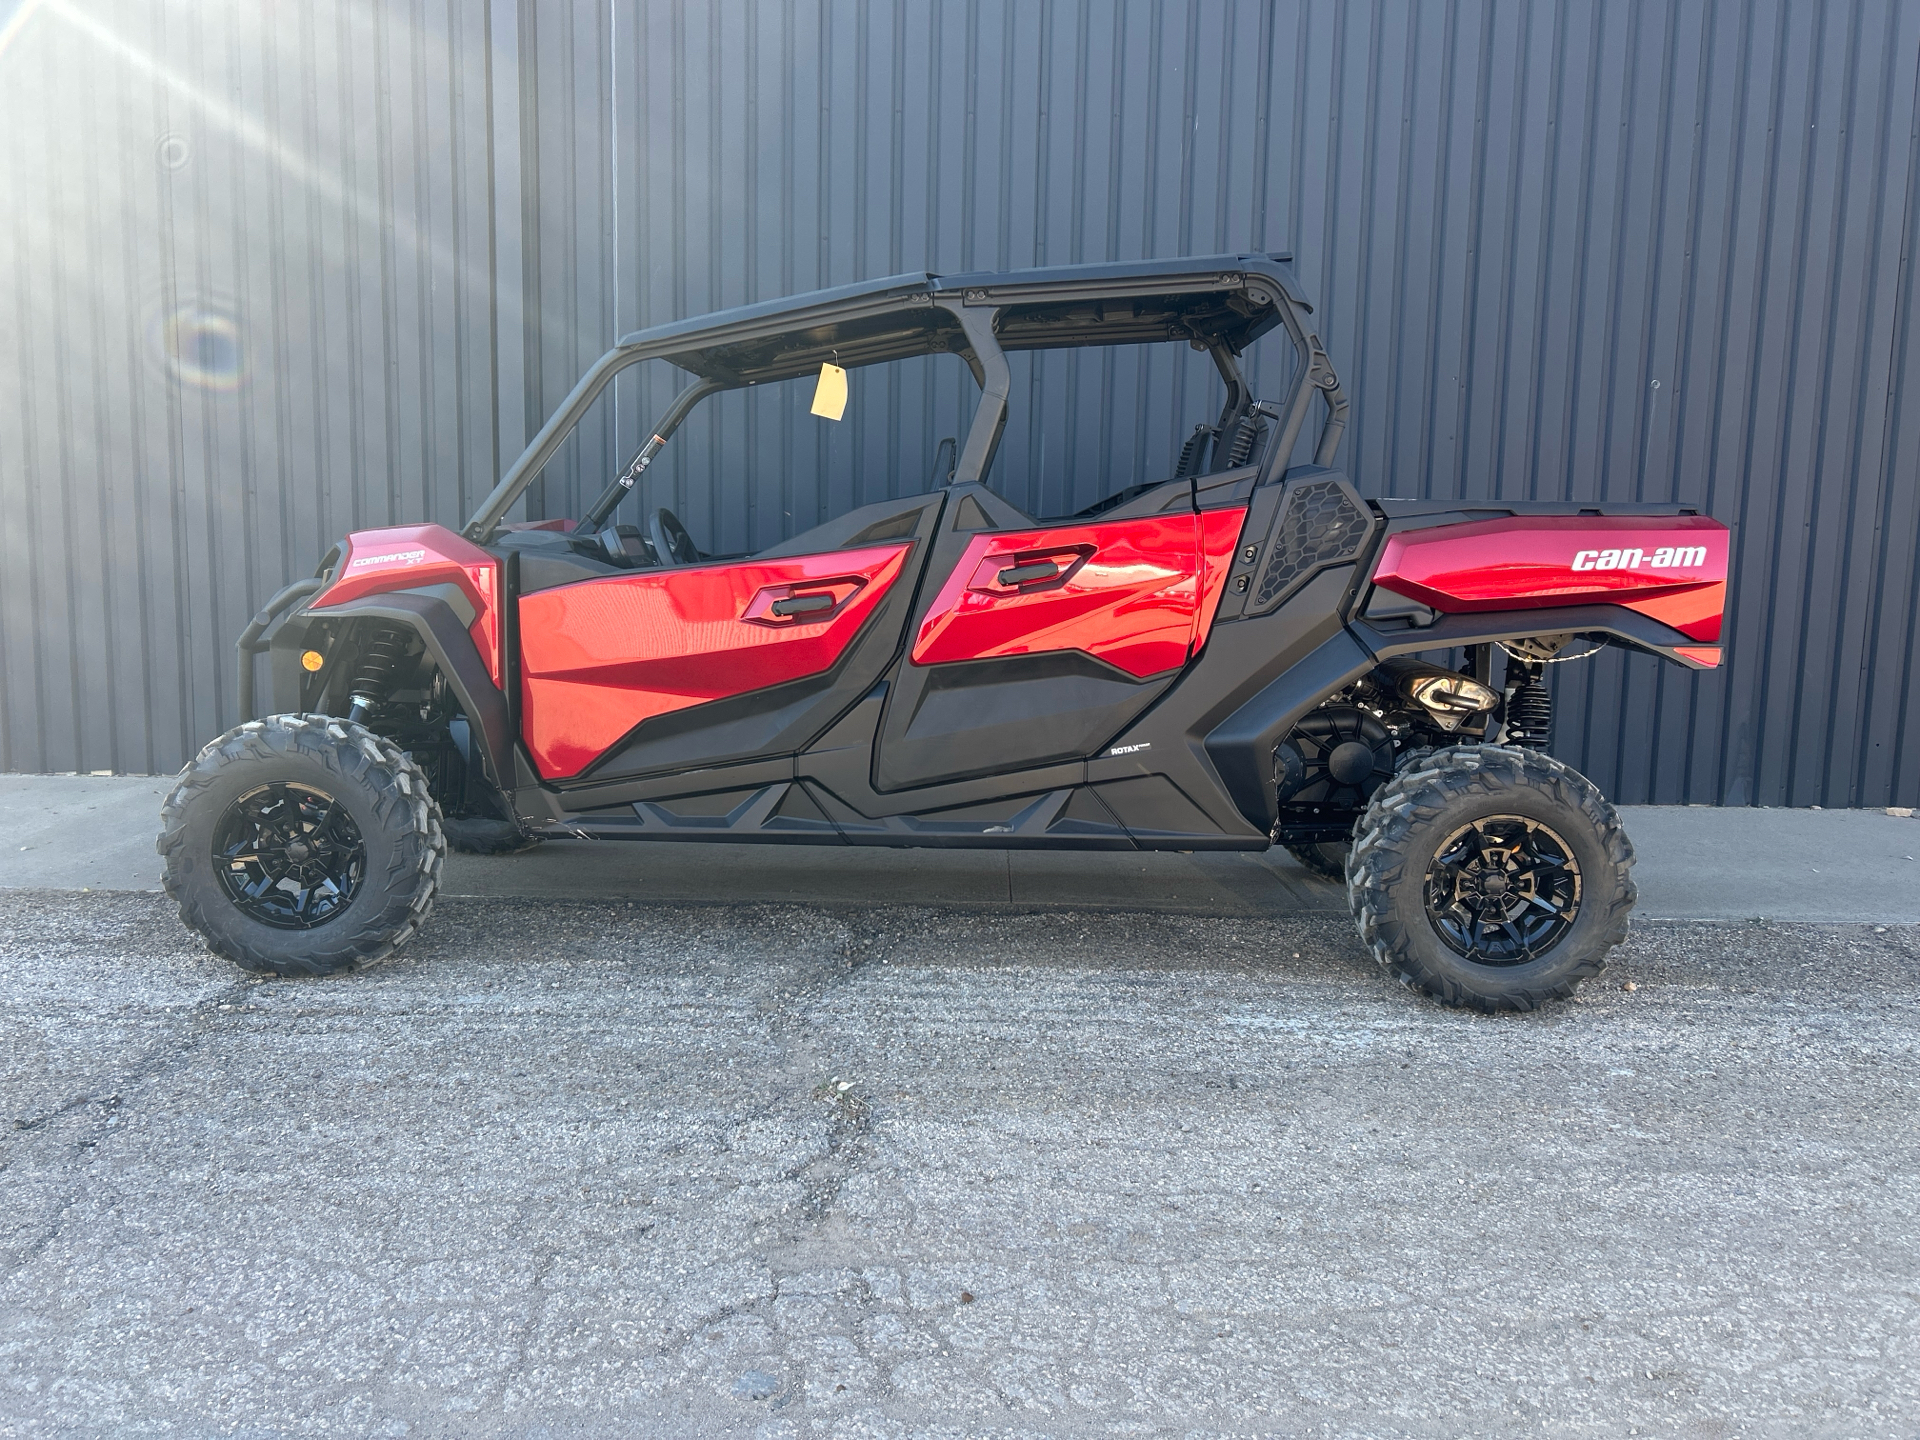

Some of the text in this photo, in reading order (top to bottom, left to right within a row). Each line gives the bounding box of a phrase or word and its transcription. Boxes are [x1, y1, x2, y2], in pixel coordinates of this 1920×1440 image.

[353, 549, 426, 567] COMMANDER
[405, 557, 424, 566] XT
[1571, 546, 1707, 571] can-am
[1110, 744, 1140, 756] ROTAX
